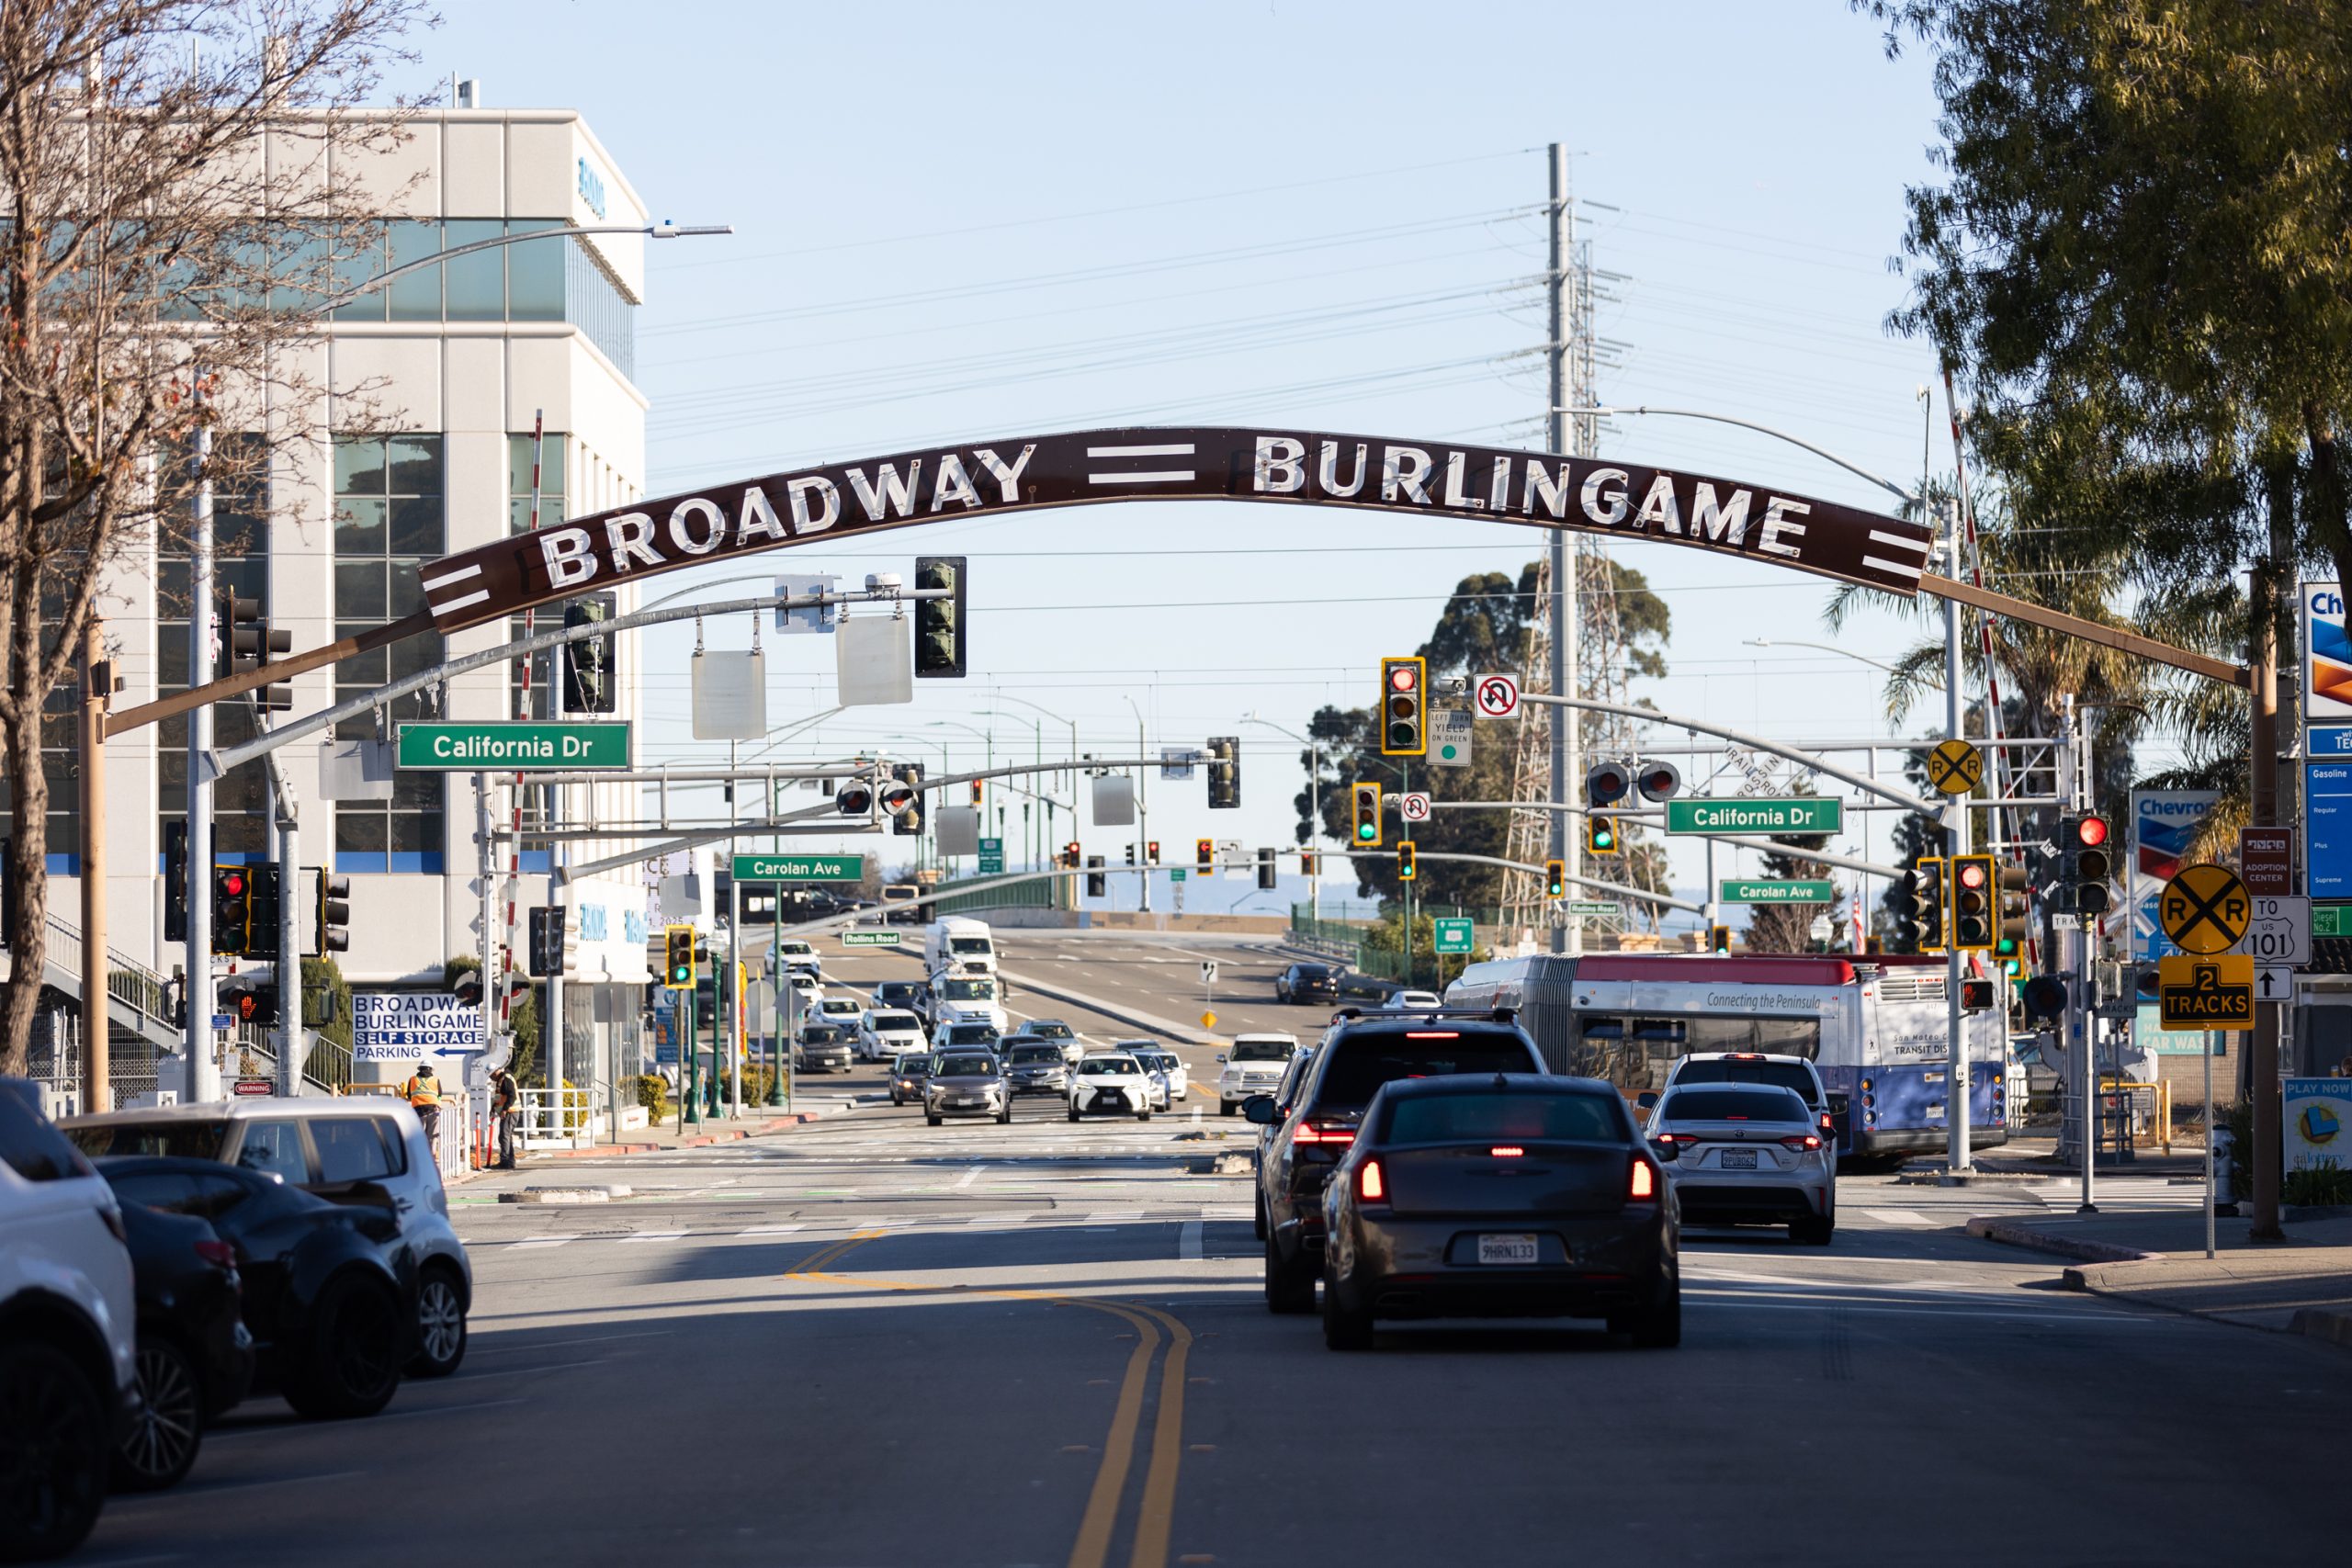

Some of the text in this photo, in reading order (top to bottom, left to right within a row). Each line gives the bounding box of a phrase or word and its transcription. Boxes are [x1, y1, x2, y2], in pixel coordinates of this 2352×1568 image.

[539, 435, 1812, 590] BROADWAY BURLINGAME
[1430, 714, 1469, 722] LEFT TURN
[1435, 724, 1465, 733] YIELD
[434, 736, 593, 758] California Dr
[1932, 761, 1978, 774] R R
[2312, 769, 2347, 778] Gasoline
[1694, 808, 1814, 826] California Dr
[753, 862, 842, 875] Carolan Ave
[2245, 863, 2288, 872] ADOPTION
[1739, 886, 1814, 898] Carolan Ave
[2167, 898, 2245, 921] R R
[2258, 900, 2278, 915] TO
[660, 918, 684, 926] 2025
[2313, 912, 2336, 922] Diesel
[846, 934, 898, 943] Rollins Road
[2251, 934, 2285, 955] 101
[2199, 970, 2214, 991] 2
[1707, 992, 1820, 1010] Connecting the Peninsula
[2166, 995, 2247, 1013] TRACKS
[355, 1015, 483, 1029] BURLINGAME
[356, 1032, 483, 1043] SELF STORAGE
[1894, 1033, 1908, 1042] San
[356, 1047, 421, 1058] PARKING
[1894, 1045, 1931, 1055] TRANSIT
[2287, 1084, 2349, 1093] PLAY NOW
[1483, 1245, 1534, 1258] 9HRN133
